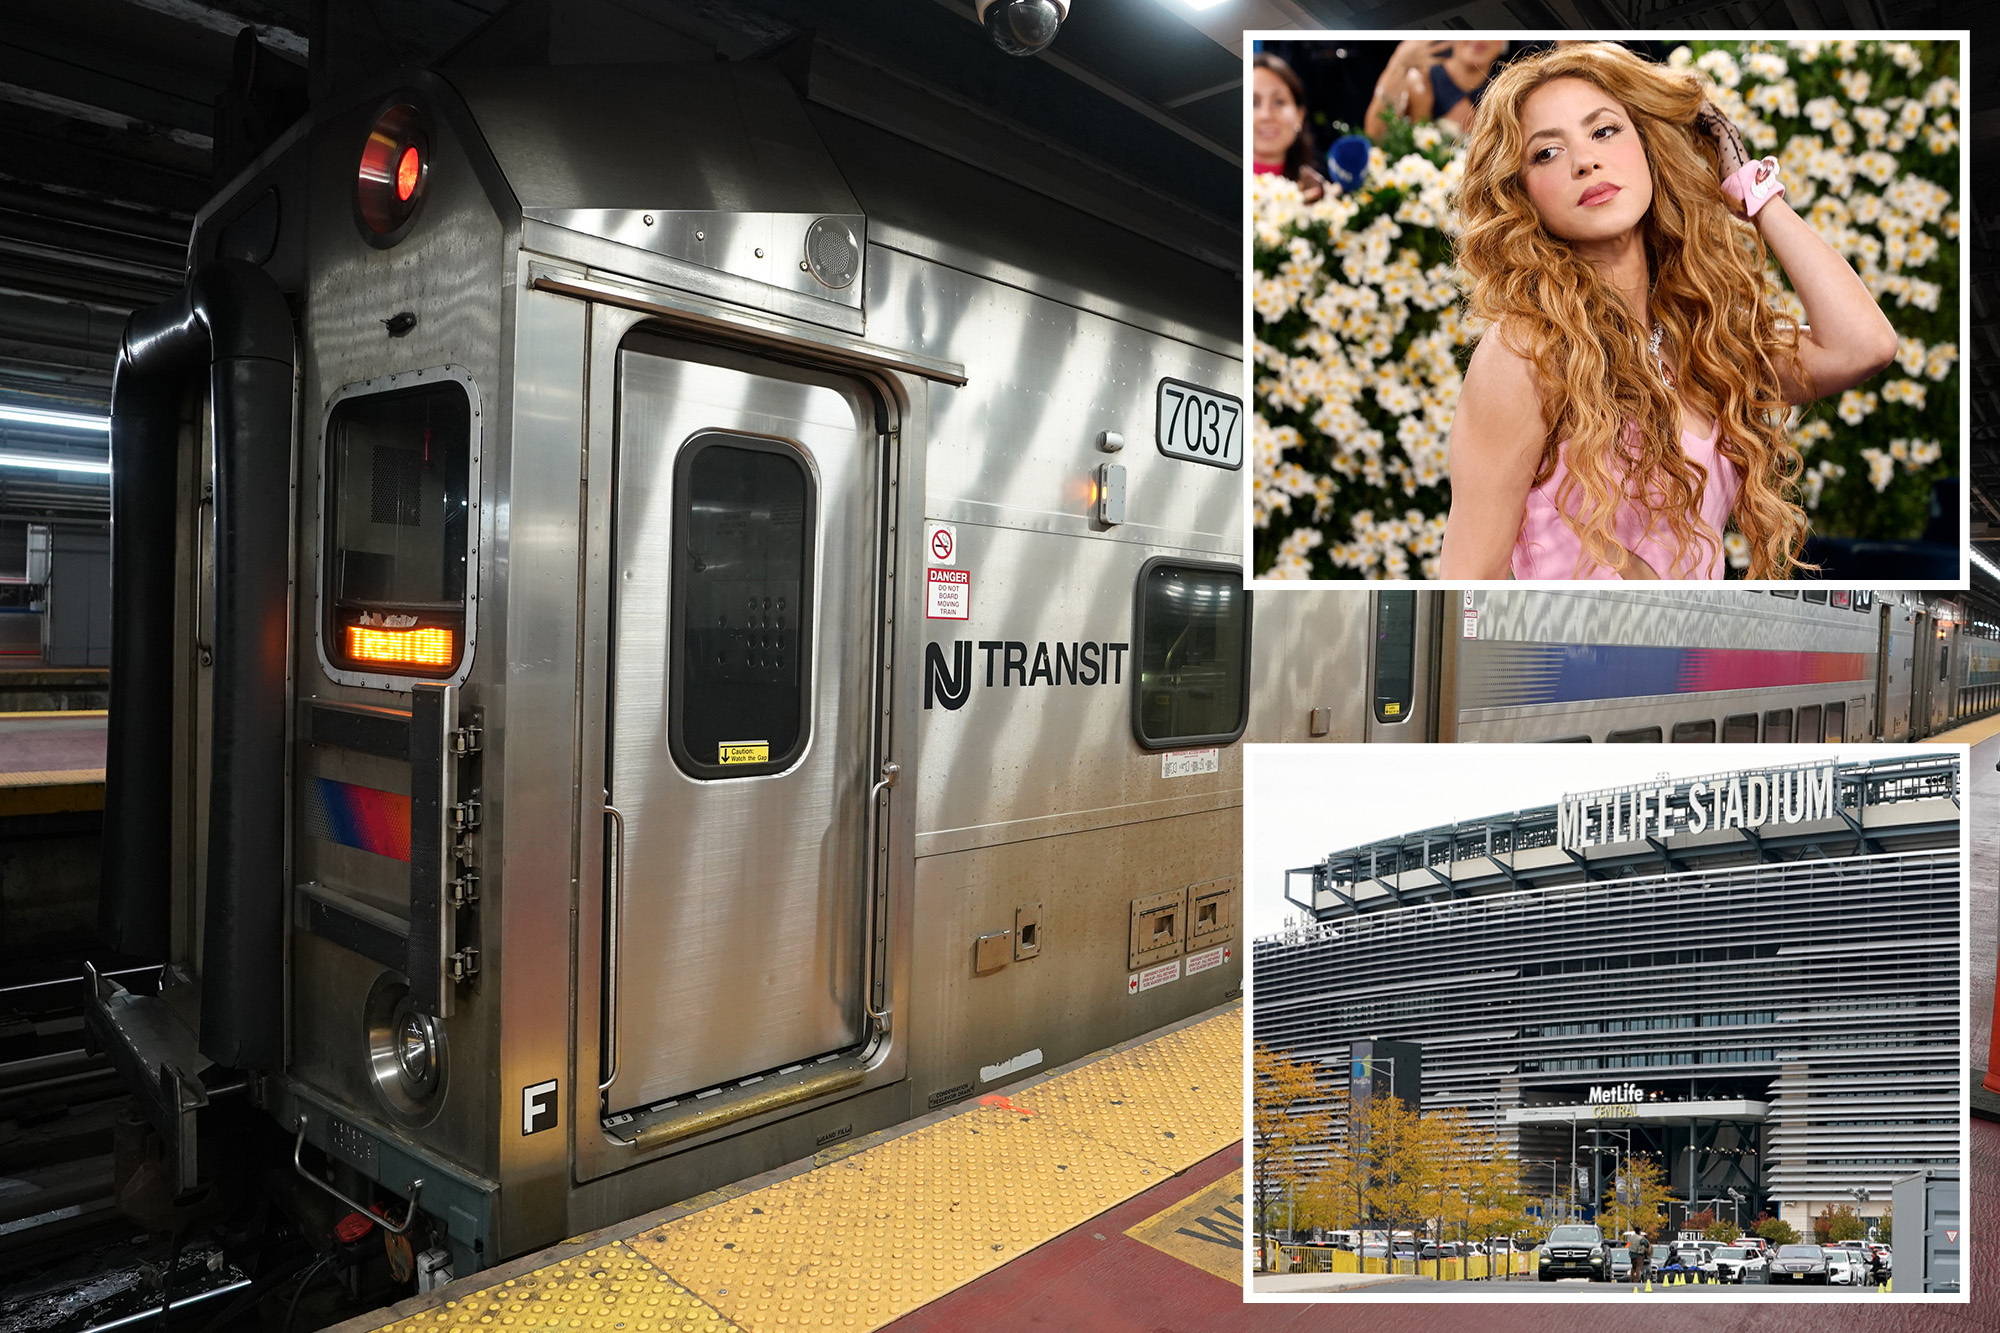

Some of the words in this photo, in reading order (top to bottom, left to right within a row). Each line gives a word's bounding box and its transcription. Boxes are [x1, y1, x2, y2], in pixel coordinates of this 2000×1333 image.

[1166, 388, 1239, 458] 7037
[931, 570, 967, 583] DANGER
[939, 592, 958, 600] BOARD
[924, 640, 973, 710] NJ
[978, 641, 1129, 687] TRANSIT
[757, 754, 767, 762] Gap
[1557, 786, 1676, 851] METLIFE
[1688, 767, 1834, 835] STADIUM
[1589, 1082, 1644, 1104] MetLife
[524, 1080, 556, 1134] F
[1593, 1104, 1638, 1119] CENTRAL
